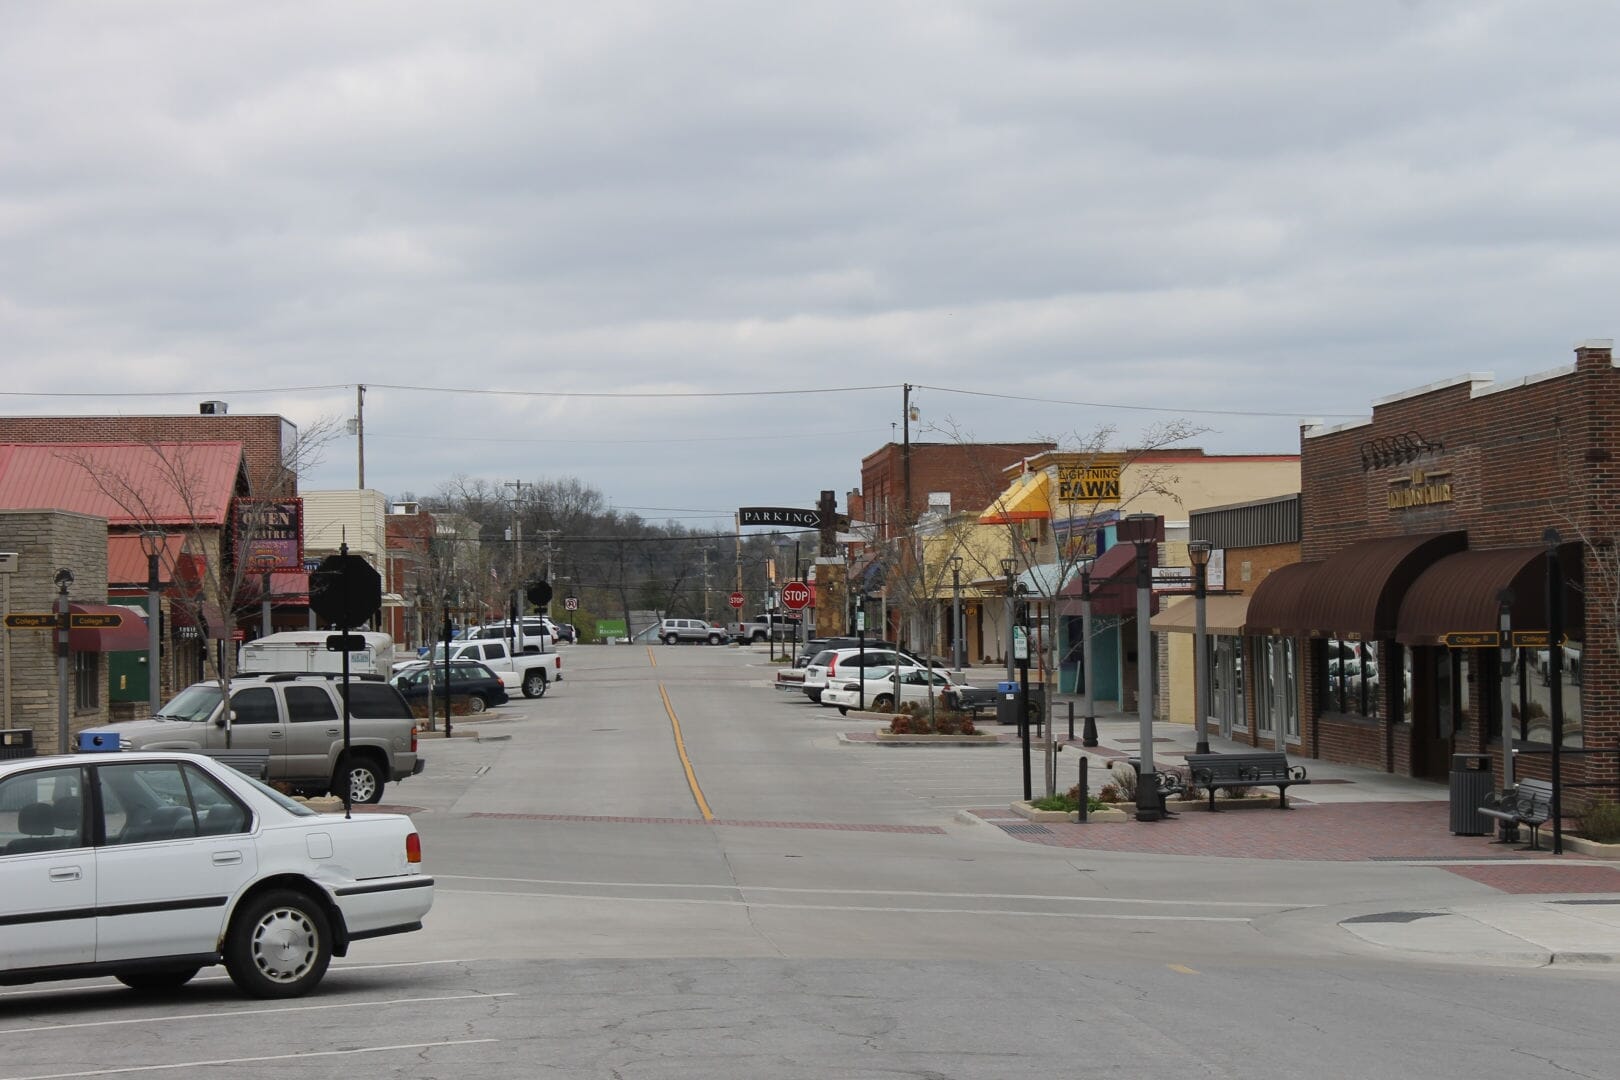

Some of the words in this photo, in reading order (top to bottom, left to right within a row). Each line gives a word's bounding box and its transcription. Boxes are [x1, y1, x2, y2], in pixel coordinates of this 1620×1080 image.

[1059, 469, 1119, 480] LIGHTNING
[1060, 481, 1119, 497] PAWN
[745, 512, 813, 523] PARKING
[784, 590, 808, 602] STOP
